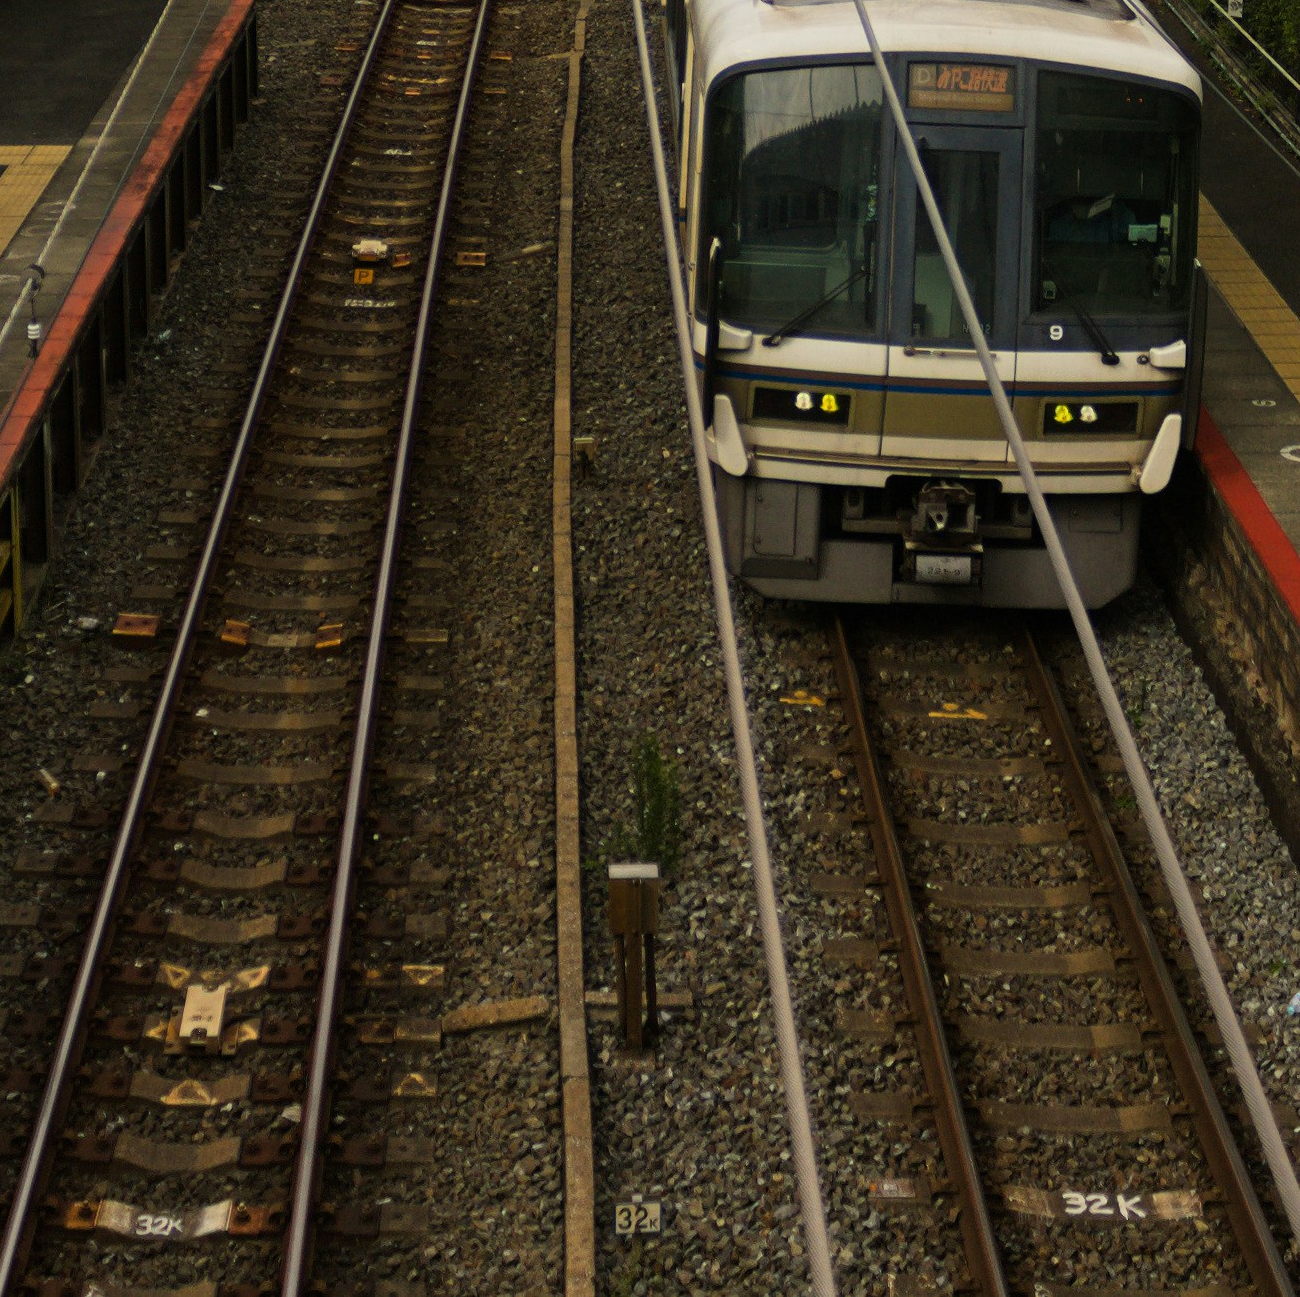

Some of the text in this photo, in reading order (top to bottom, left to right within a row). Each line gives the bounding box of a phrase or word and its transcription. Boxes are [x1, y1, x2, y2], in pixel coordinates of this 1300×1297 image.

[1050, 324, 1064, 341] 9
[1062, 1191, 1146, 1220] 32K
[136, 1214, 183, 1236] 32K
